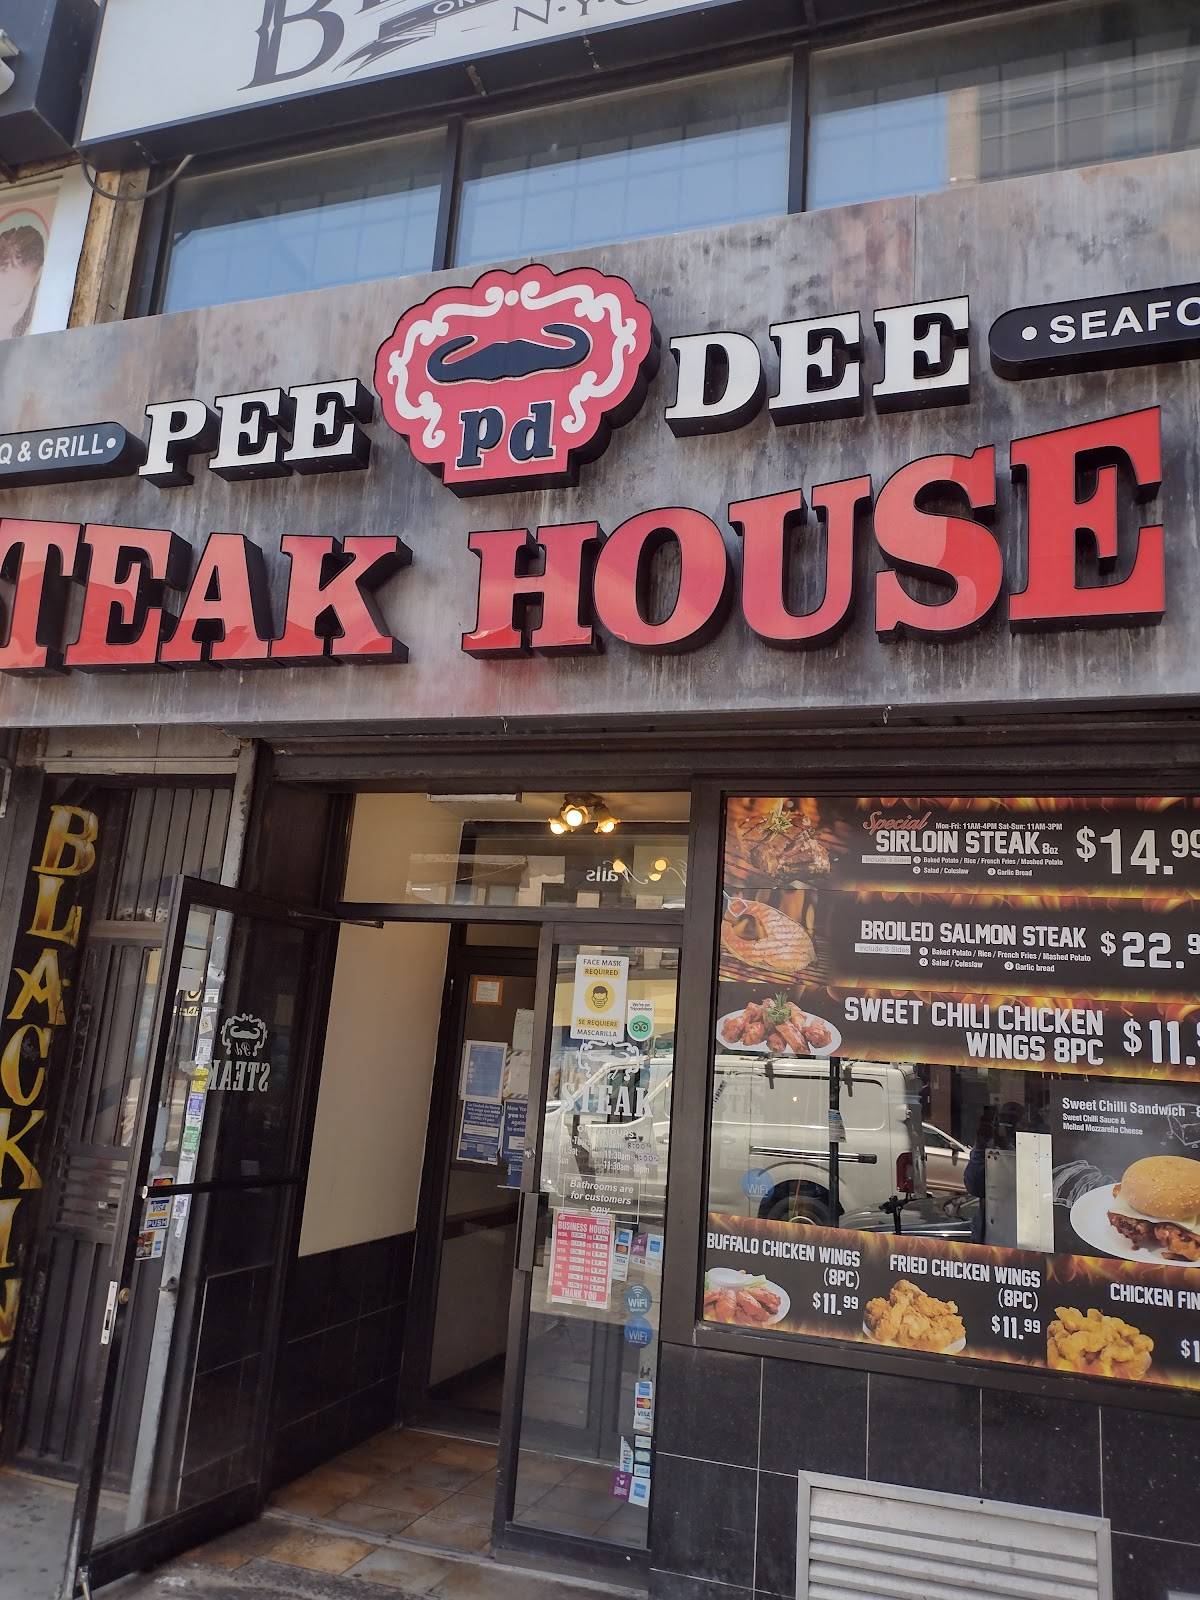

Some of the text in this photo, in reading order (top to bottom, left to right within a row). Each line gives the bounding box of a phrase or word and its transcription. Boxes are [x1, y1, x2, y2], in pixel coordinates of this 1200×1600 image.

[1050, 296, 1200, 344] SEAFO
[138, 296, 970, 477] PEE DEE
[455, 399, 557, 471] pd
[17, 440, 32, 463] &
[38, 433, 104, 460] GRILL
[0, 405, 1165, 670] TEAK HOUSE
[863, 811, 932, 836] Special
[962, 822, 997, 830] 11AM-4PM
[876, 830, 959, 853] SIRLOIN
[965, 831, 1040, 855] STEAK
[1076, 826, 1200, 875] $14.99
[1021, 858, 1043, 866] Mashed
[1044, 858, 1063, 866] Potato
[861, 920, 934, 942] BROILED
[939, 922, 1017, 946] SALMON
[1022, 925, 1087, 948] STEAK
[931, 947, 950, 956] Baked
[951, 948, 972, 957] Potato
[977, 949, 992, 958] Rice
[997, 950, 1020, 959] French
[1020, 951, 1037, 960] Fries
[1042, 953, 1068, 961] Mashed
[1069, 954, 1091, 962] Potato
[931, 959, 949, 967] Salad
[954, 960, 983, 968] Coleslaw
[584, 968, 619, 976] REQUIRED
[1015, 963, 1035, 972] Garlic
[1035, 964, 1055, 973] bread
[844, 996, 924, 1025] SWEET
[931, 1001, 990, 1030] CHILI
[998, 1005, 1104, 1036] CHICKEN
[577, 1029, 617, 1037] MASCARILLA
[966, 1031, 1104, 1065] WINGS 8PC
[561, 1082, 654, 1118] STEAK
[1062, 1097, 1097, 1110] Sweet
[1099, 1100, 1127, 1113] Chilli
[1129, 1101, 1186, 1117] Sandwich
[1062, 1113, 1126, 1125] Sweet Chilli Sauce &
[1062, 1122, 1143, 1135] Melted Mozzarella Cheese
[569, 1180, 634, 1193] Bathrooms are
[570, 1190, 632, 1205] for customers
[146, 1218, 168, 1229] PUSH
[558, 1220, 610, 1235] BUSINESS HOURS
[706, 1232, 861, 1267] BUFFALO CHICKEN WINGS
[823, 1267, 860, 1290] (8PC)
[889, 1254, 1041, 1288] FRIED CHICKEN WINGS
[561, 1287, 597, 1301] THANK YOU
[812, 1291, 859, 1315] $11.99
[998, 1287, 1039, 1312] (8PC)
[1110, 1282, 1174, 1308] CHICKEN
[991, 1314, 1041, 1340] $11.99
